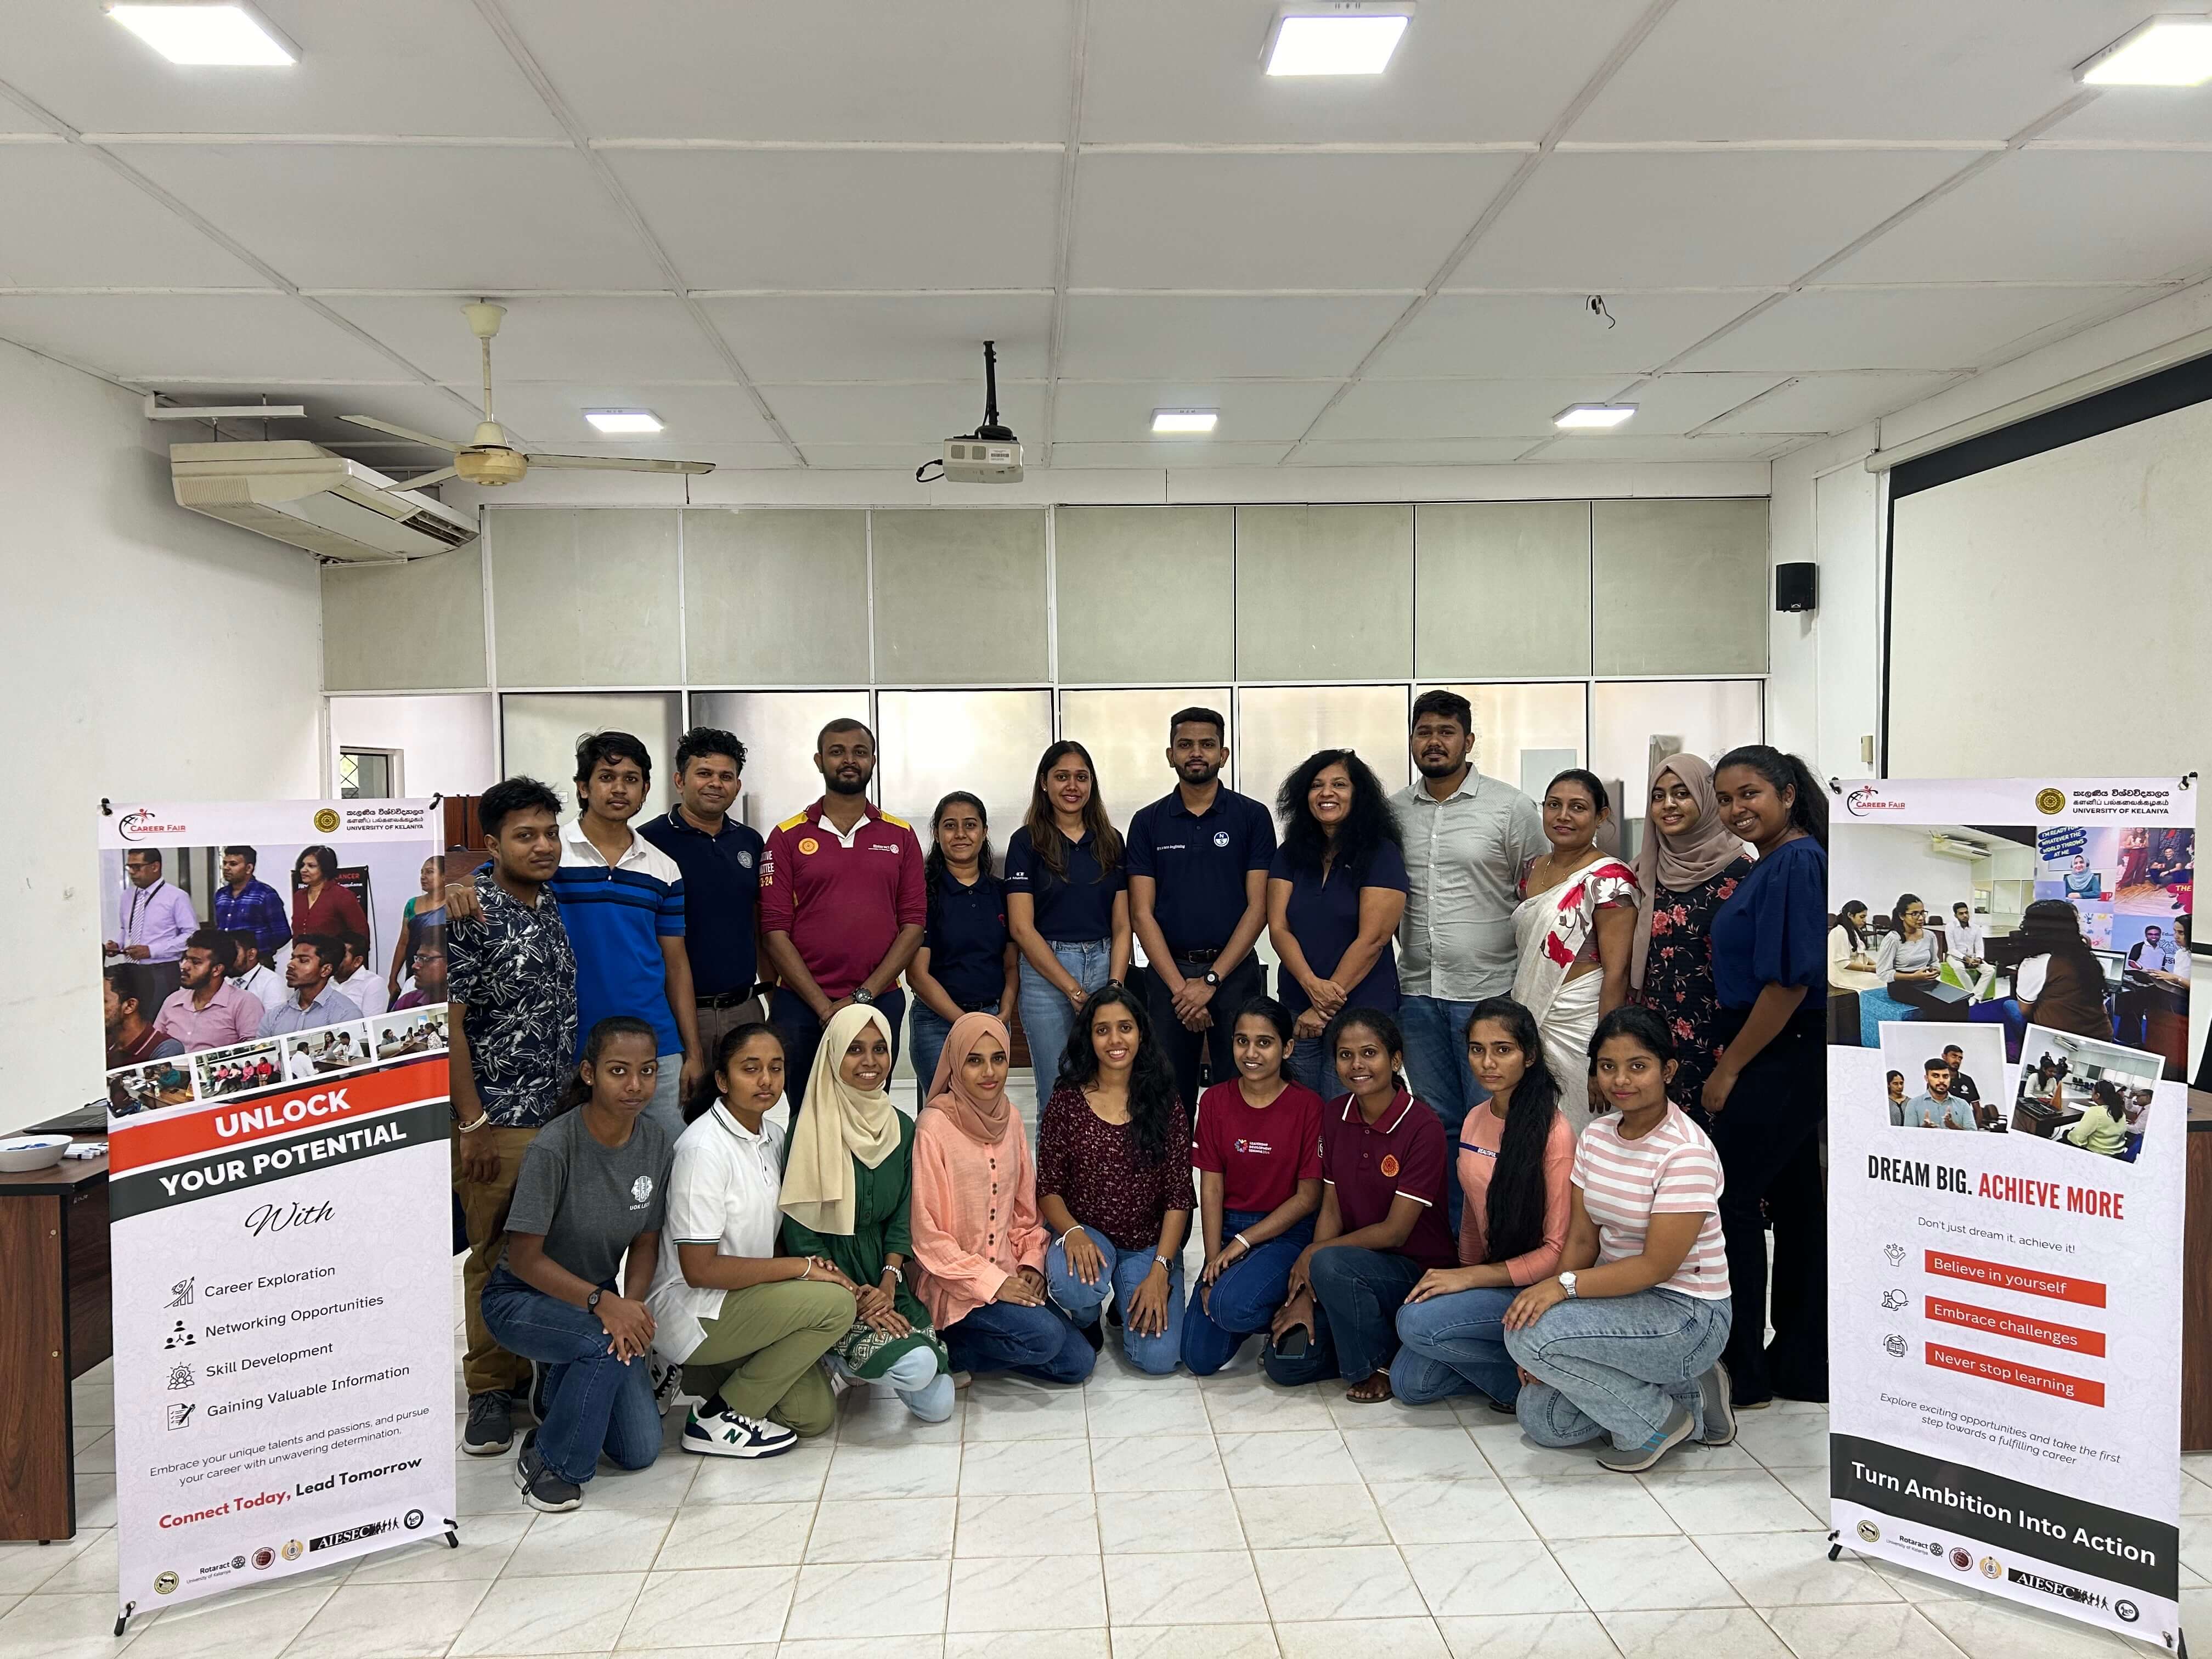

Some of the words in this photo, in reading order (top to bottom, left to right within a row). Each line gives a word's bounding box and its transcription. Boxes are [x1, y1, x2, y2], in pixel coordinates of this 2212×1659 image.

[2042, 834, 2069, 845] WHATEVER
[2042, 845, 2061, 853] WORLD
[2061, 838, 2084, 848] THROWS
[2050, 827, 2067, 836] READY
[215, 1088, 351, 1137] UNLOCK
[159, 1160, 247, 1196] YOUR
[253, 1122, 407, 1175] POTENTIAL
[1869, 1155, 1929, 1187] DREAM
[1937, 1166, 1972, 1195] BIG.
[1979, 1173, 2059, 1209] ACHIEVE
[2068, 1187, 2124, 1220] MORE
[245, 1201, 335, 1237] With
[1918, 1217, 1944, 1229] Don't
[1946, 1223, 1966, 1234] just
[1970, 1227, 2003, 1240] dream
[2007, 1233, 2016, 1243] it,
[2019, 1237, 2062, 1251] achieve
[2066, 1244, 2075, 1254] it!
[205, 1282, 253, 1296] Career
[258, 1268, 335, 1288] Exploration
[1935, 1258, 1984, 1277] Believe
[1989, 1268, 2001, 1281] in
[2006, 1275, 2067, 1294] yourself
[206, 1315, 285, 1337] Networking
[291, 1297, 383, 1321] Opportunities
[1935, 1304, 1995, 1327] Embrace
[2000, 1320, 2077, 1345] challenges
[206, 1362, 236, 1376] Skill
[242, 1344, 332, 1370] Development
[1936, 1351, 1976, 1369] Never
[1980, 1364, 2011, 1379] stop
[2016, 1369, 2074, 1396] learning
[208, 1398, 262, 1416] Gaining
[268, 1384, 326, 1403] Valuable
[332, 1367, 409, 1390] Information
[151, 1460, 199, 1476] Embrace
[202, 1454, 226, 1467] your
[230, 1446, 265, 1459] unique
[269, 1436, 303, 1449] talents
[306, 1430, 324, 1441] and
[328, 1421, 373, 1438] passions,
[375, 1414, 393, 1425] and
[397, 1408, 429, 1423] pursue
[1881, 1393, 1916, 1408] Explore
[1920, 1404, 1957, 1420] exciting
[1960, 1415, 2027, 1438] opportunities
[2030, 1432, 2050, 1444] and
[2053, 1438, 2076, 1452] take
[2080, 1446, 2096, 1457] the
[2100, 1451, 2120, 1463] first
[1921, 1417, 1943, 1429] step
[1946, 1421, 1987, 1439] towards
[1999, 1435, 2040, 1456] fulfilling
[2042, 1451, 2076, 1464] career
[179, 1474, 204, 1487] your
[207, 1465, 241, 1478] career
[244, 1459, 266, 1469] with
[269, 1444, 328, 1464] unwavering
[331, 1428, 401, 1449] determination,
[160, 1503, 229, 1528] Connect
[234, 1492, 290, 1510] Today,
[296, 1475, 334, 1496] Lead
[339, 1459, 421, 1485] Tomorrow
[1852, 1462, 1899, 1491] Turn
[1905, 1479, 2011, 1523] Ambition
[2019, 1510, 2066, 1539] Into
[2073, 1528, 2154, 1566] Action
[318, 1526, 370, 1549] AIESEC
[1899, 1535, 1928, 1549] Rotaract
[200, 1562, 230, 1574] Rotaract
[2017, 1574, 2074, 1598] AIESEC
